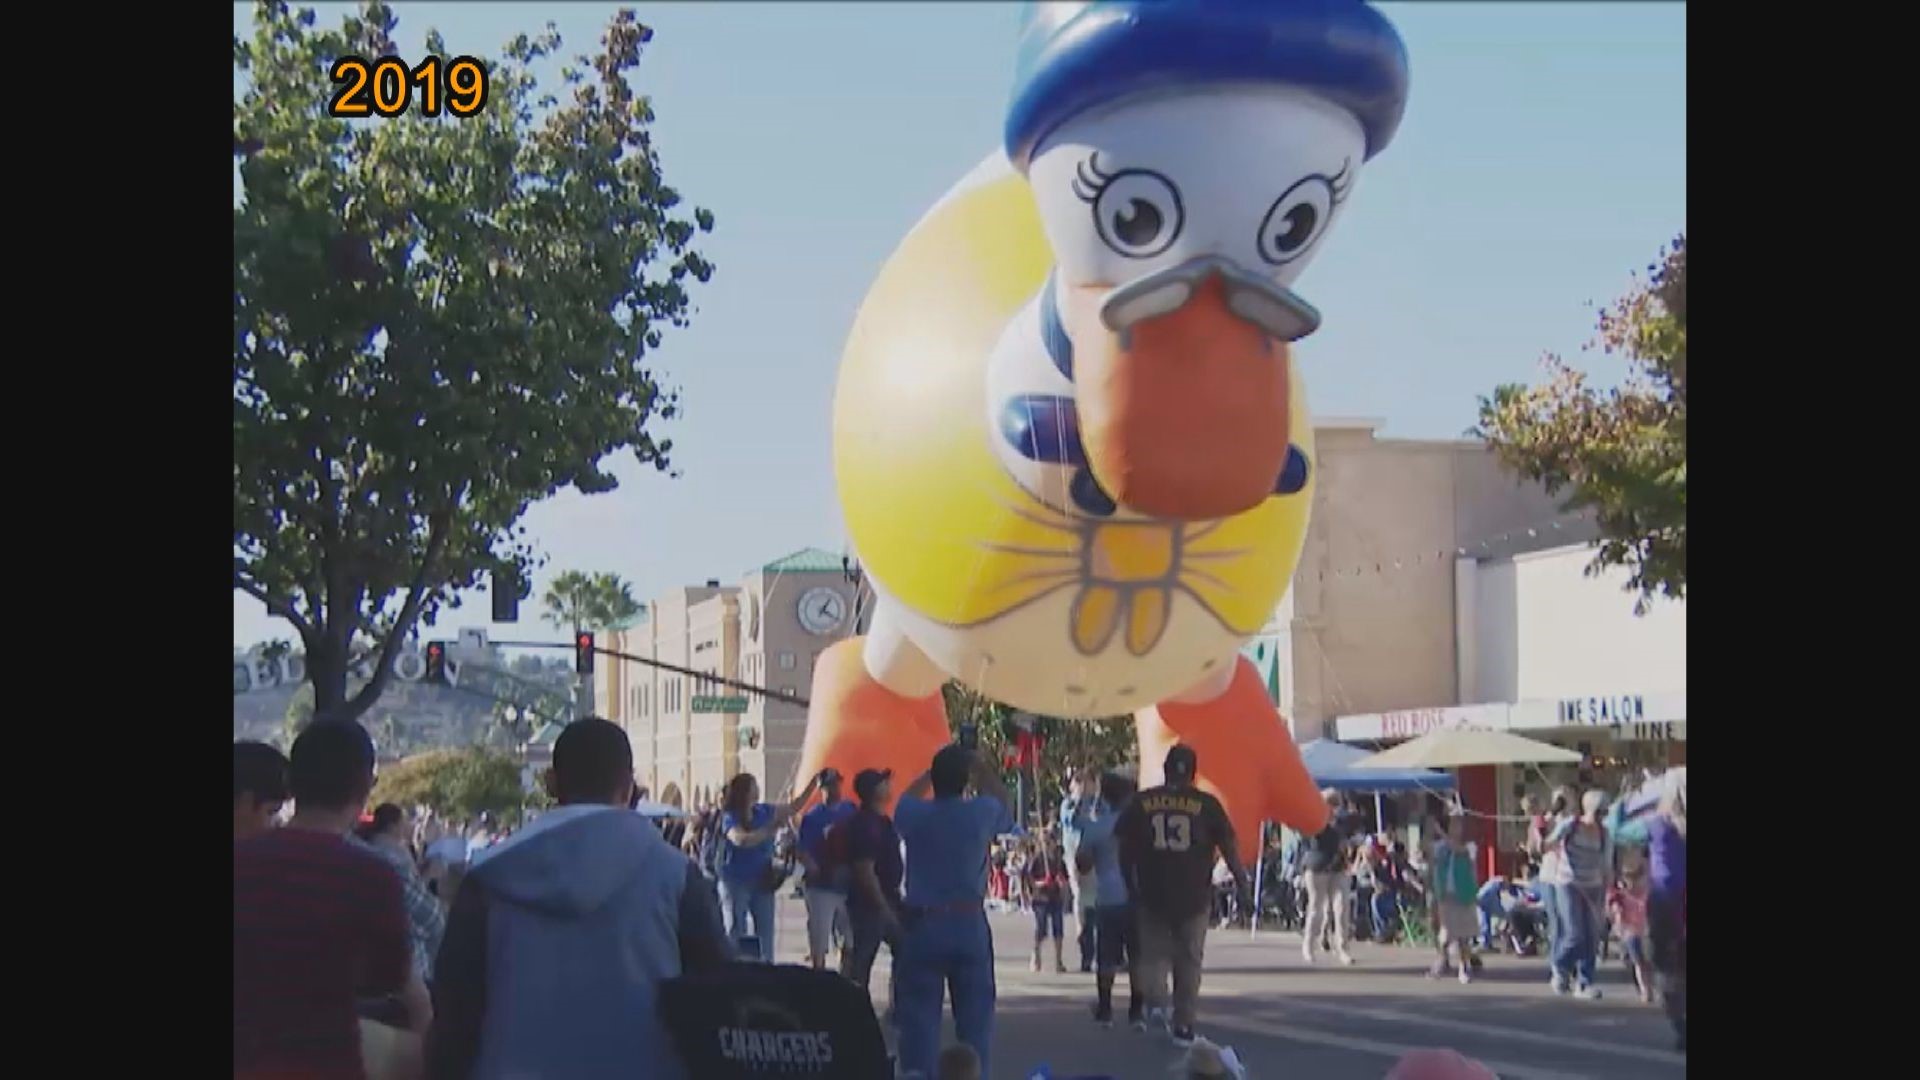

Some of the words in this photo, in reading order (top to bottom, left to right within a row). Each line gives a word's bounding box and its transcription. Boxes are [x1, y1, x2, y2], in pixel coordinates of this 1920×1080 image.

[1589, 696, 1643, 724] SALON
[1151, 813, 1191, 852] 13
[718, 1026, 833, 1063] CHARGERS
